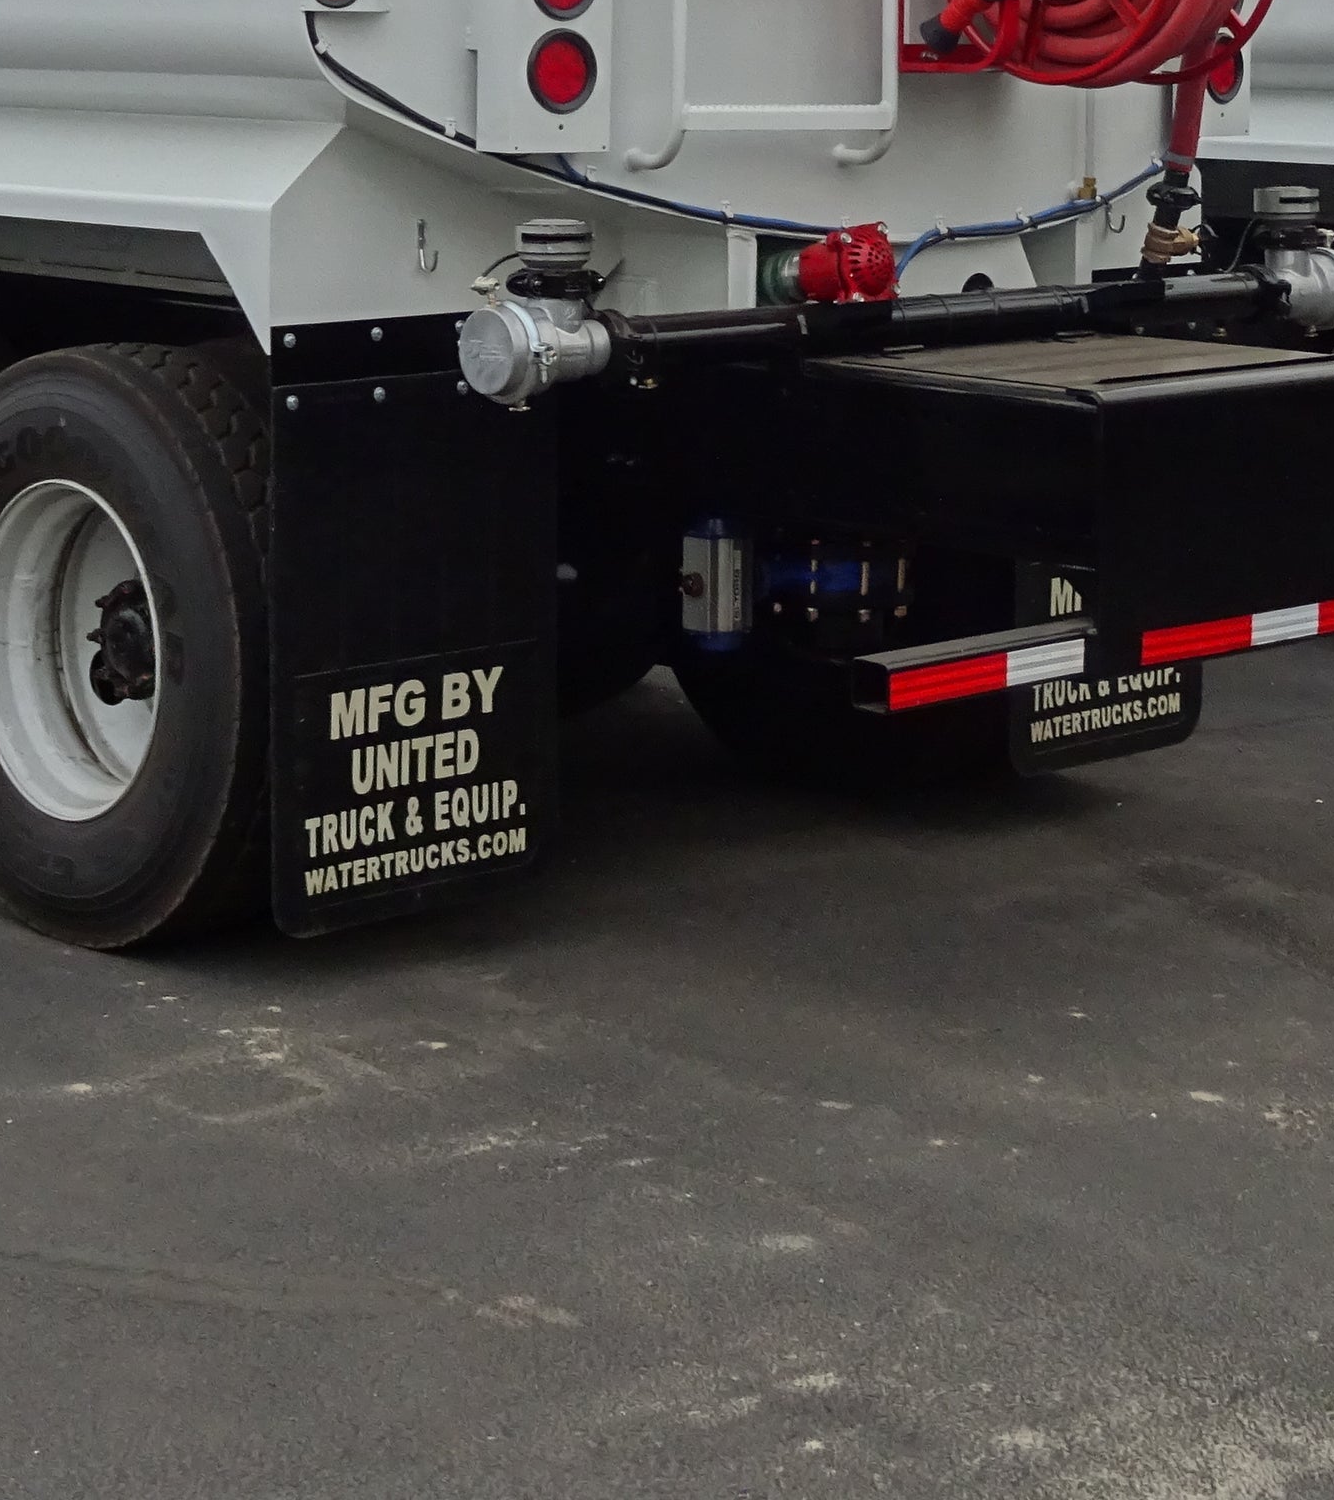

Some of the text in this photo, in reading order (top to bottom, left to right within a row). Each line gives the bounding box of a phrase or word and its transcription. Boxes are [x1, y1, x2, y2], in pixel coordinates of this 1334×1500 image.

[330, 665, 504, 740] MFG BY
[1030, 693, 1181, 742] WATERTRUCKS.COM
[351, 728, 480, 795] UNITED
[305, 780, 527, 858] TRUCK & EQUIP.
[305, 827, 527, 896] WATERTRUCKS.COM
